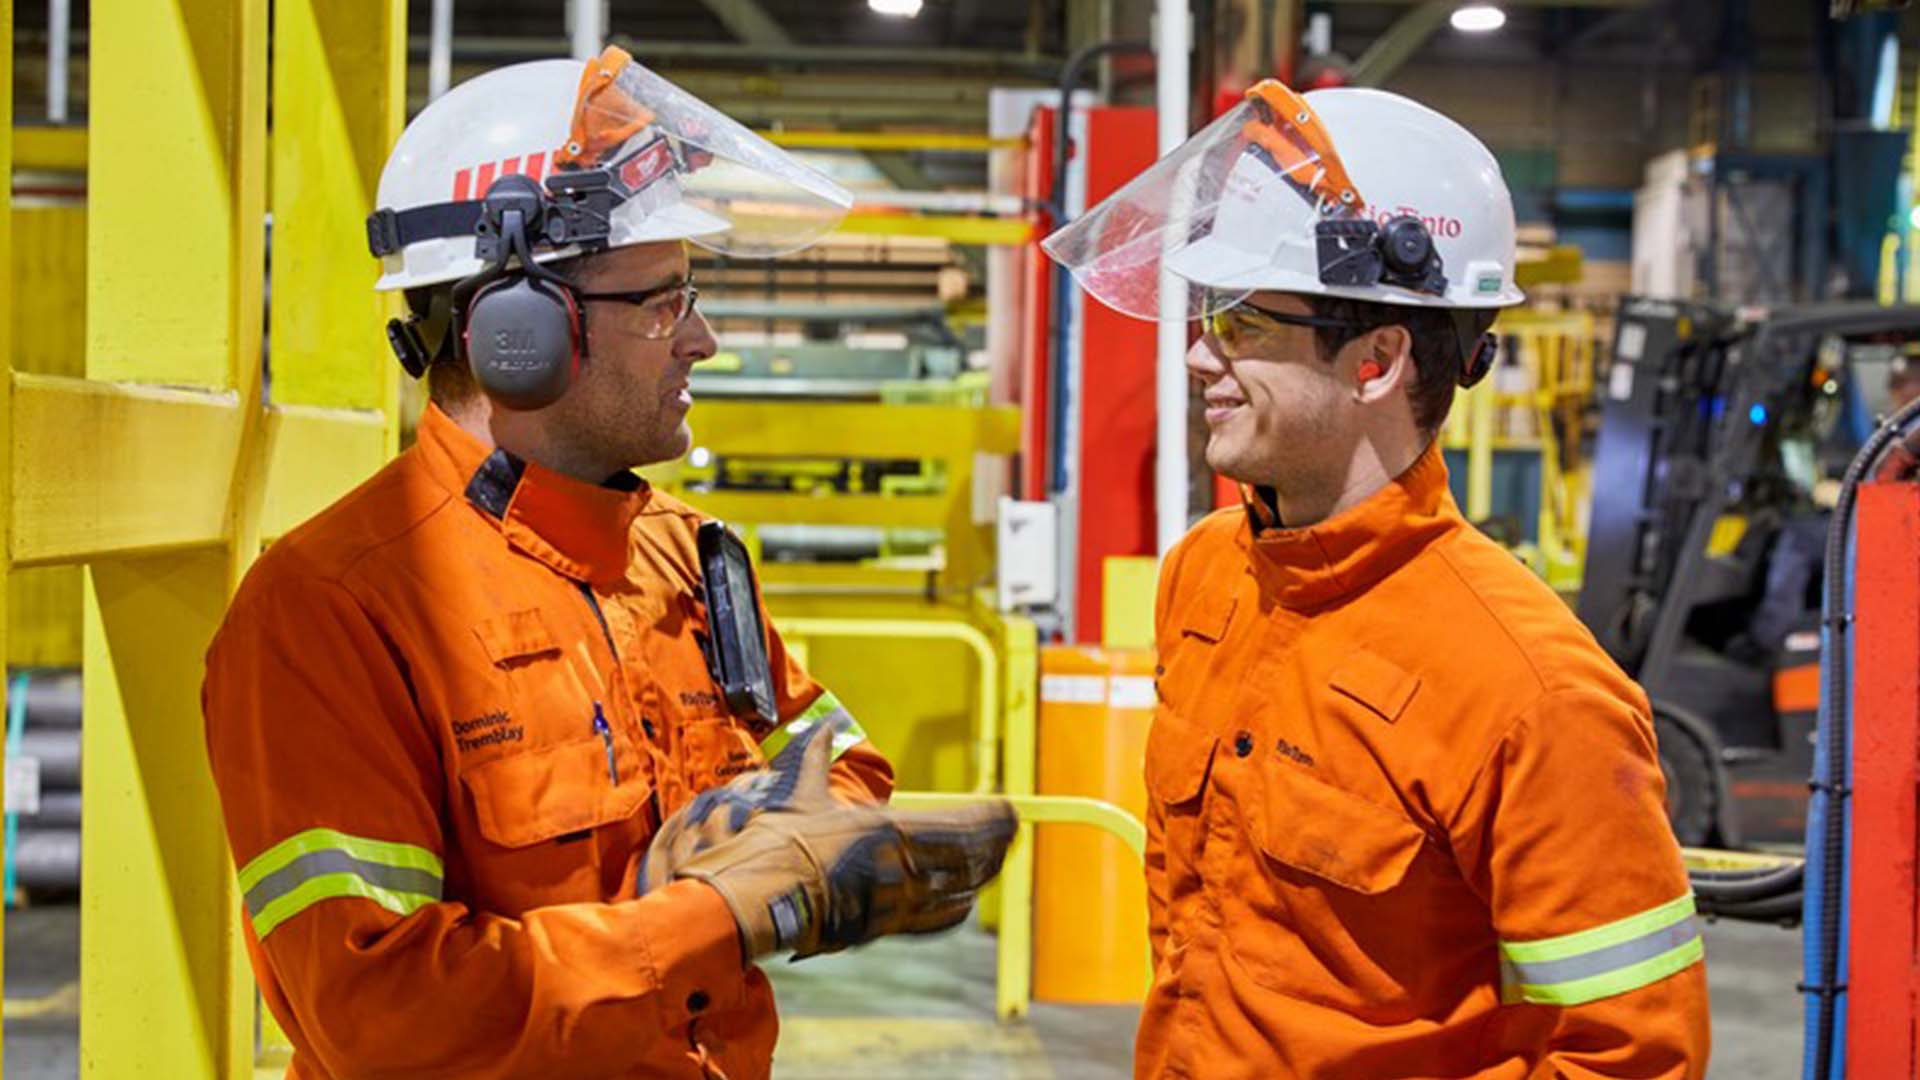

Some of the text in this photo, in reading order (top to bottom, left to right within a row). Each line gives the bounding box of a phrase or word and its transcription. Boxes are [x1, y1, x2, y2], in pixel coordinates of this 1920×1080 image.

[497, 328, 538, 354] 3M
[452, 708, 511, 735] Dominic
[456, 725, 524, 752] Tremblay
